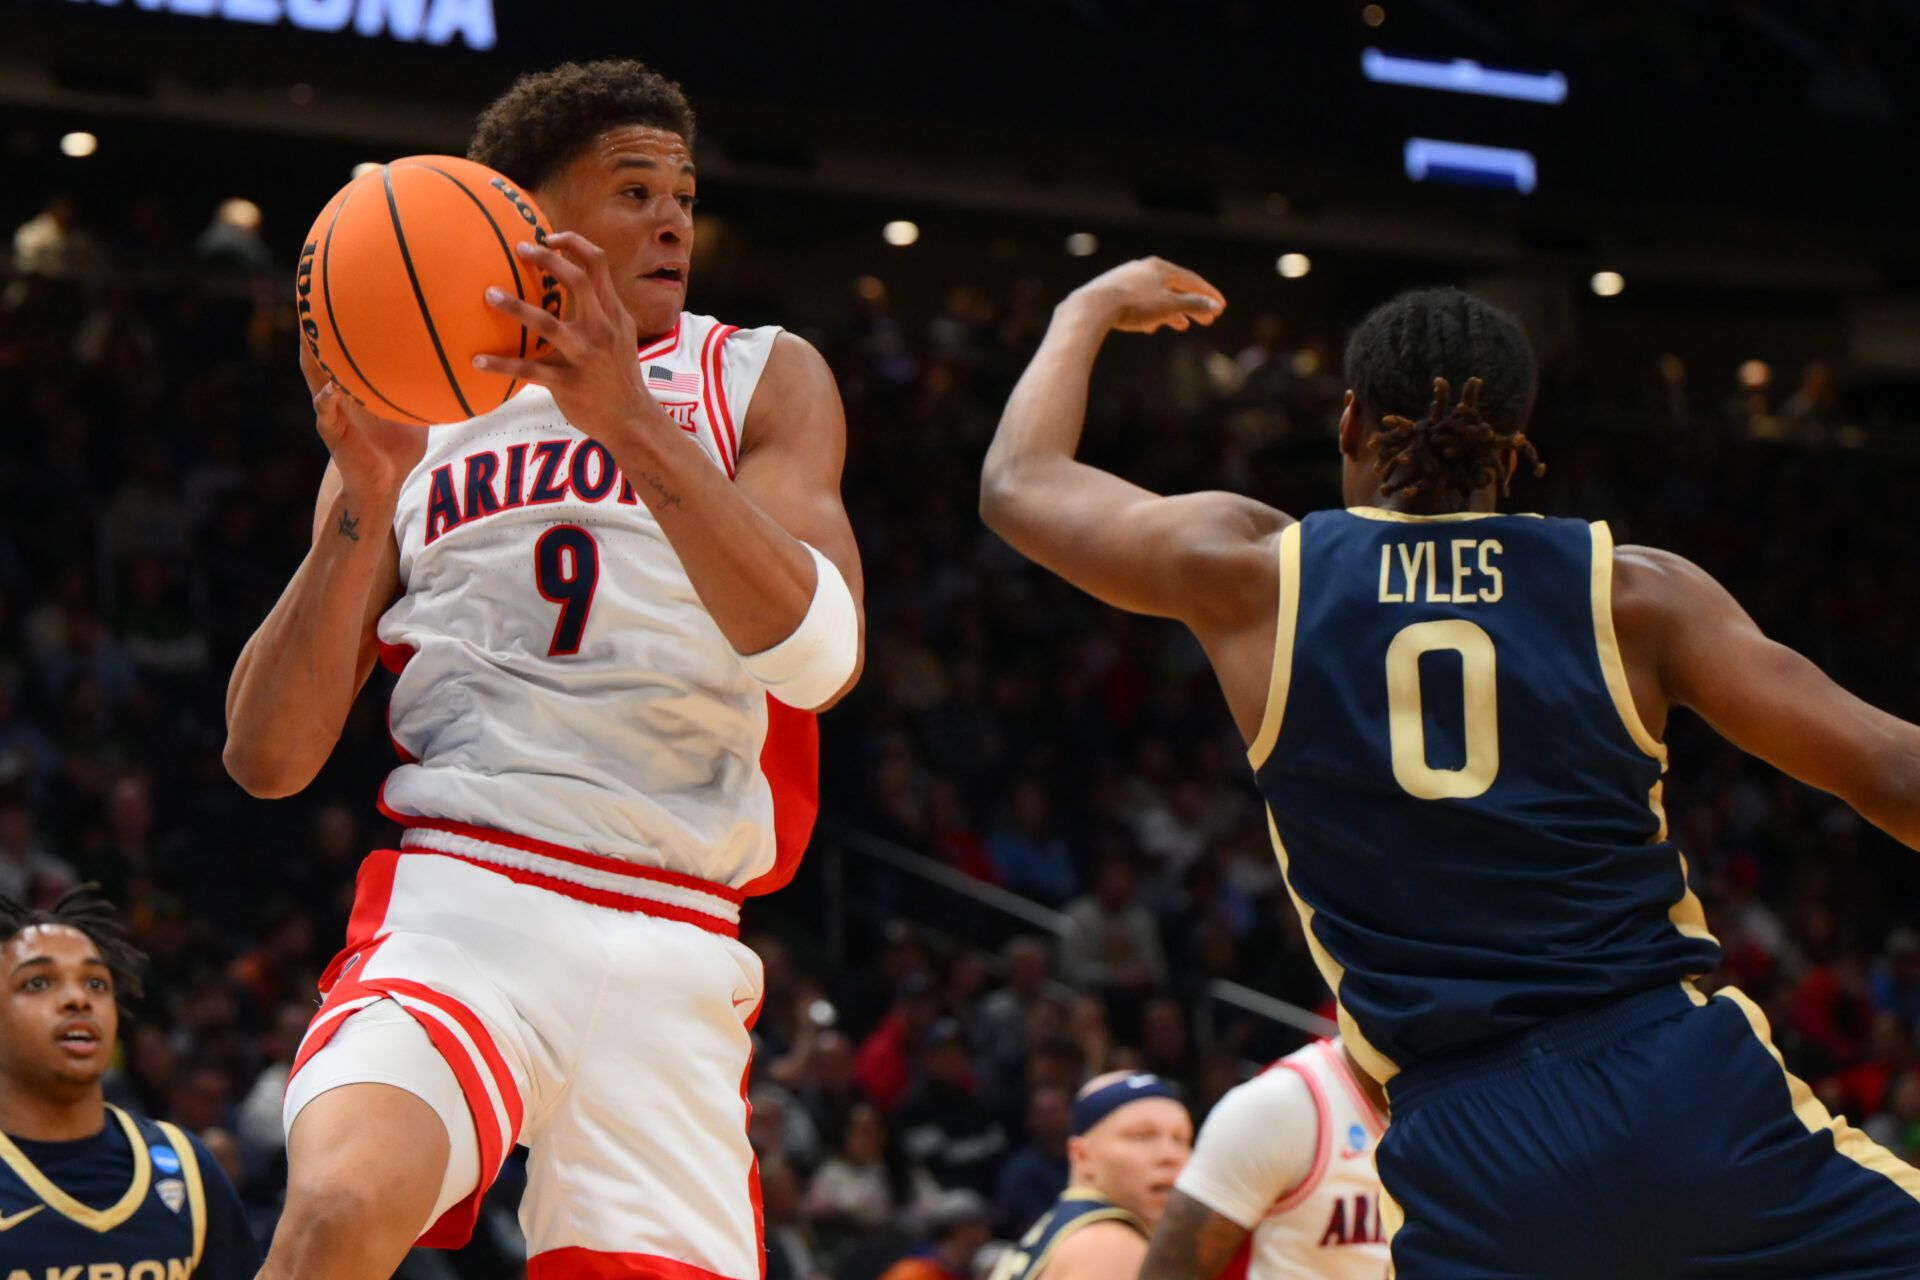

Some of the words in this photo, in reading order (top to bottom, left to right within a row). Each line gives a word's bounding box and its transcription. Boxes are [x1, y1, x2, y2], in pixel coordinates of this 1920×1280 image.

[297, 240, 366, 407] Wils
[489, 177, 562, 350] Wison
[424, 437, 637, 546] ARIZO
[534, 524, 600, 657] 9
[1378, 539, 1503, 603] LYLES
[1385, 619, 1499, 799] 0
[5, 1256, 194, 1280] RON
